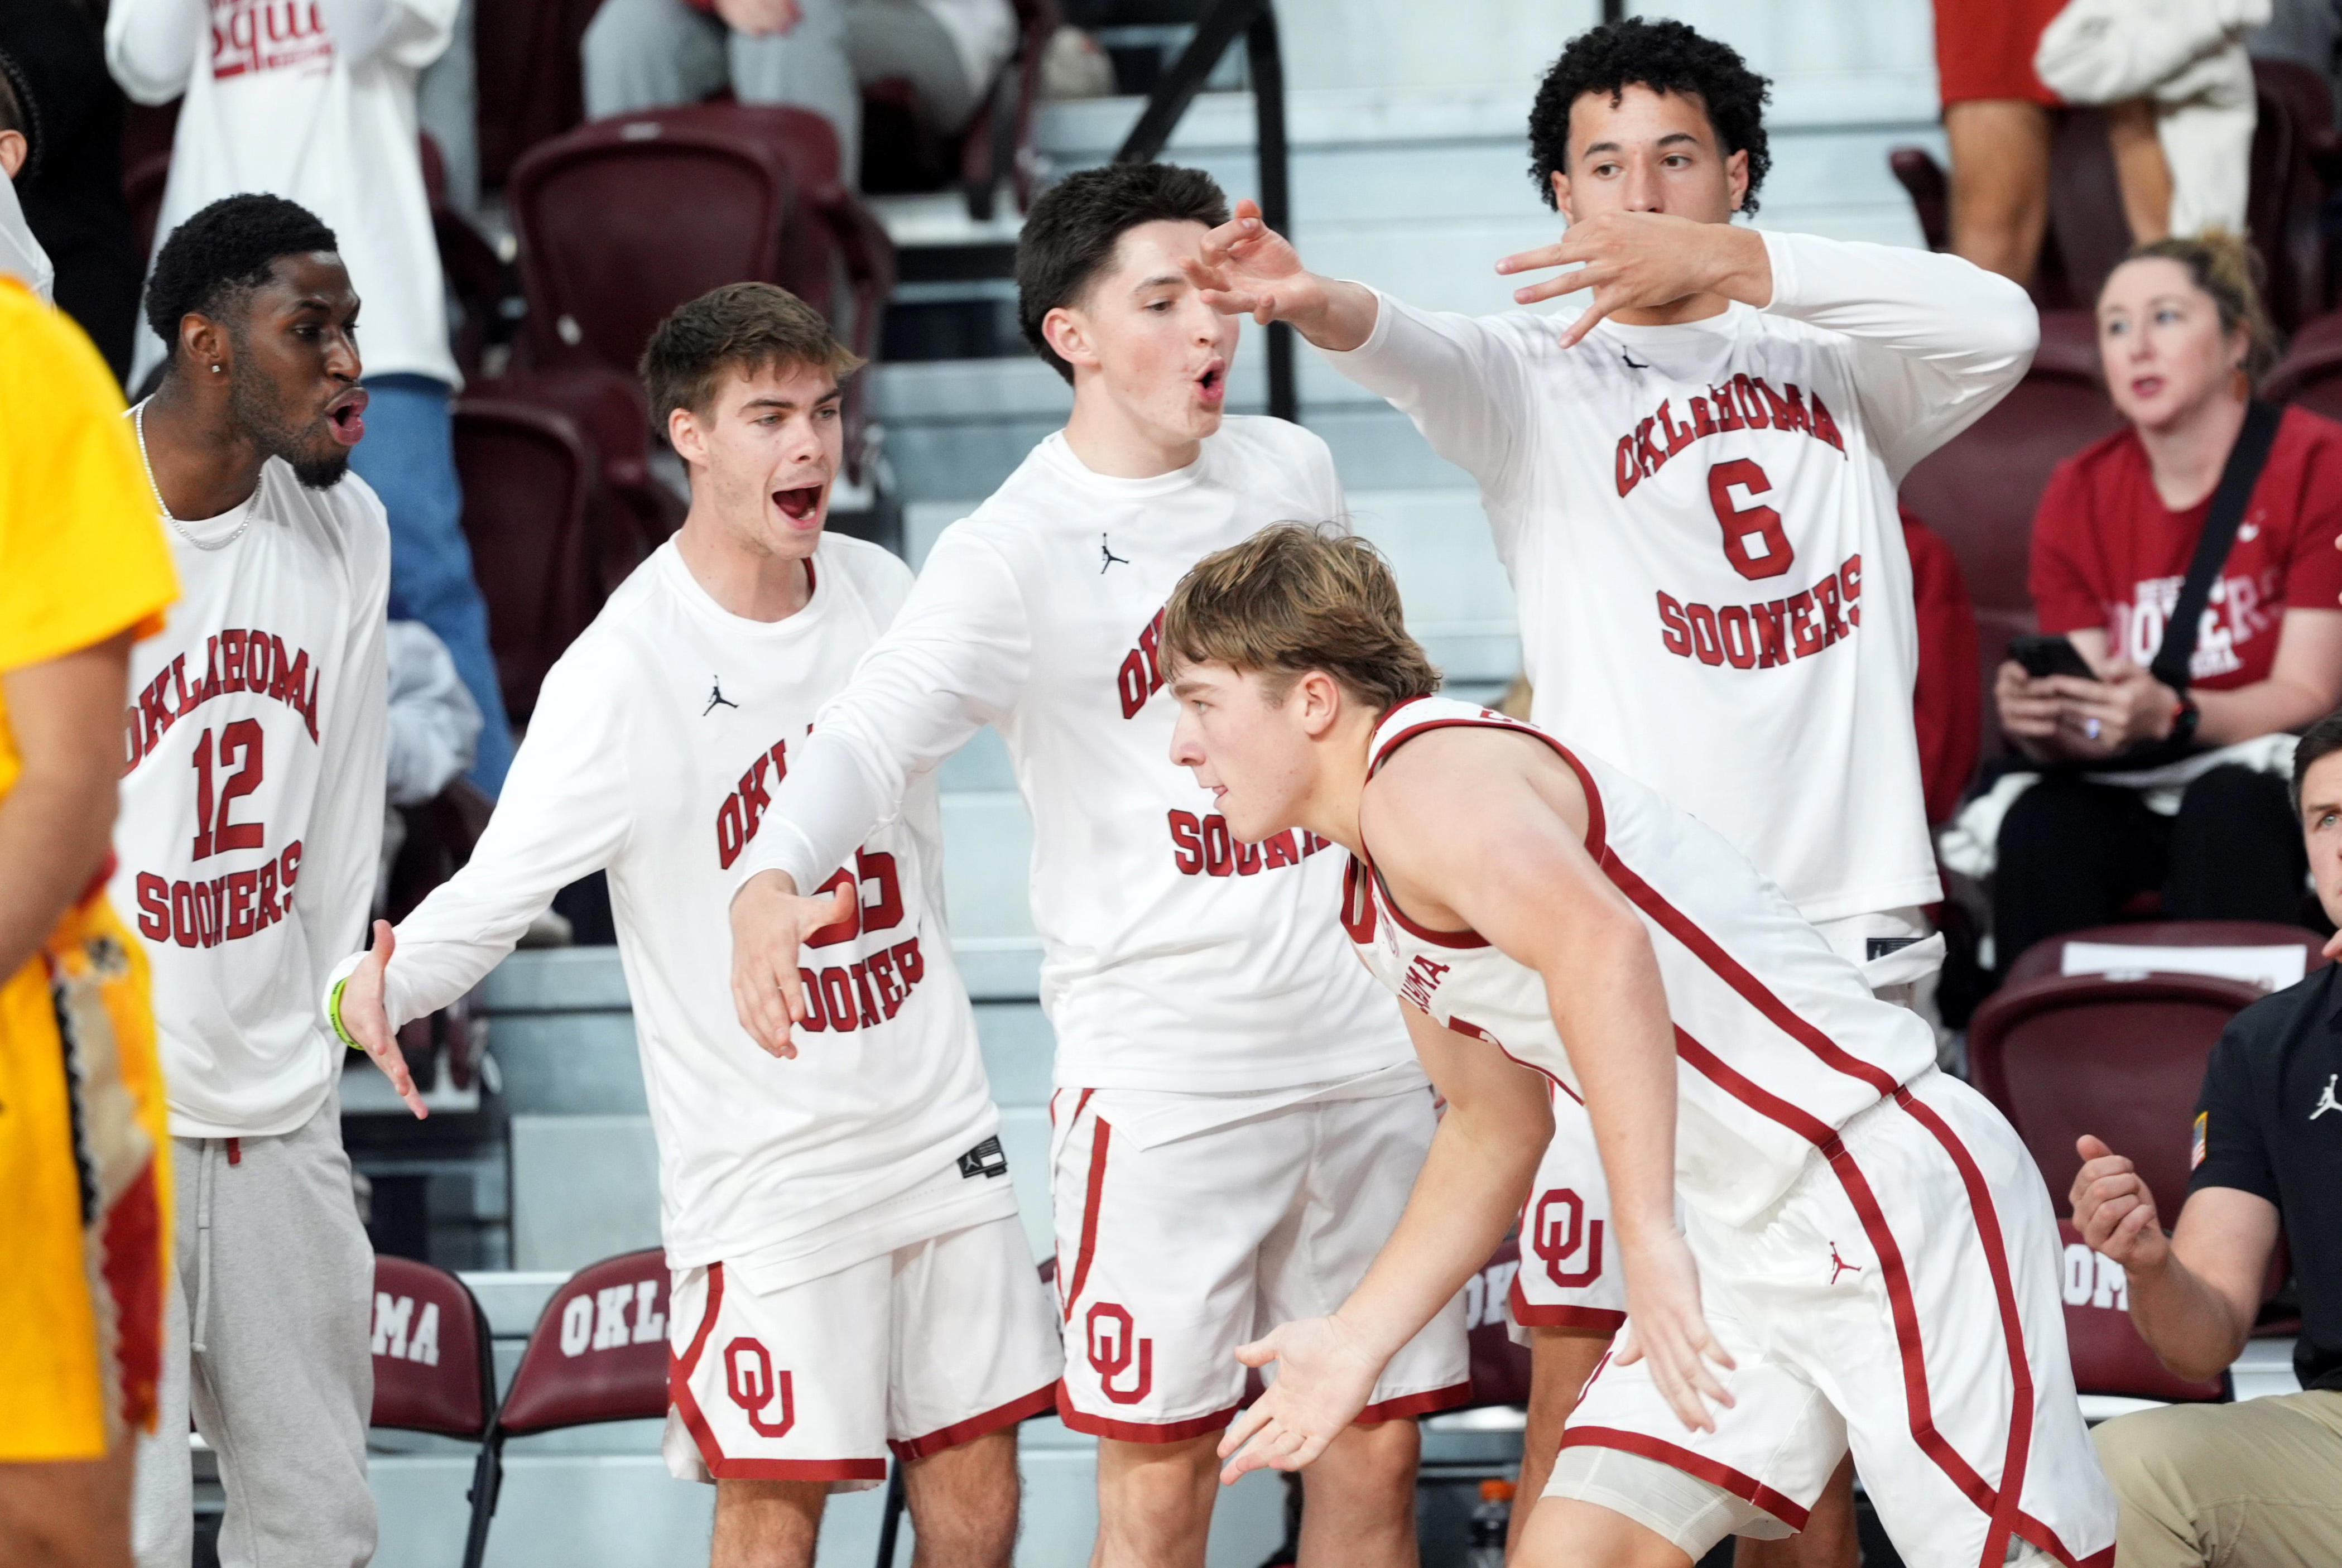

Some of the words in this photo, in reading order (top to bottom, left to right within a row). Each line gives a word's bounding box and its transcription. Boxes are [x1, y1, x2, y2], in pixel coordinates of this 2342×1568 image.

[1616, 373, 1848, 498] OKLAHOMA
[1708, 458, 1794, 580] 6
[1656, 554, 1861, 670] SOONERS
[122, 629, 319, 780] OKLAHOMA
[193, 718, 264, 862] 12
[1167, 809, 1331, 877] SOON
[136, 840, 302, 949] SOONERS
[1533, 1188, 1604, 1288] OU
[560, 1280, 671, 1358] OKL
[1086, 1302, 1152, 1405] OU
[724, 1337, 795, 1438] OU
